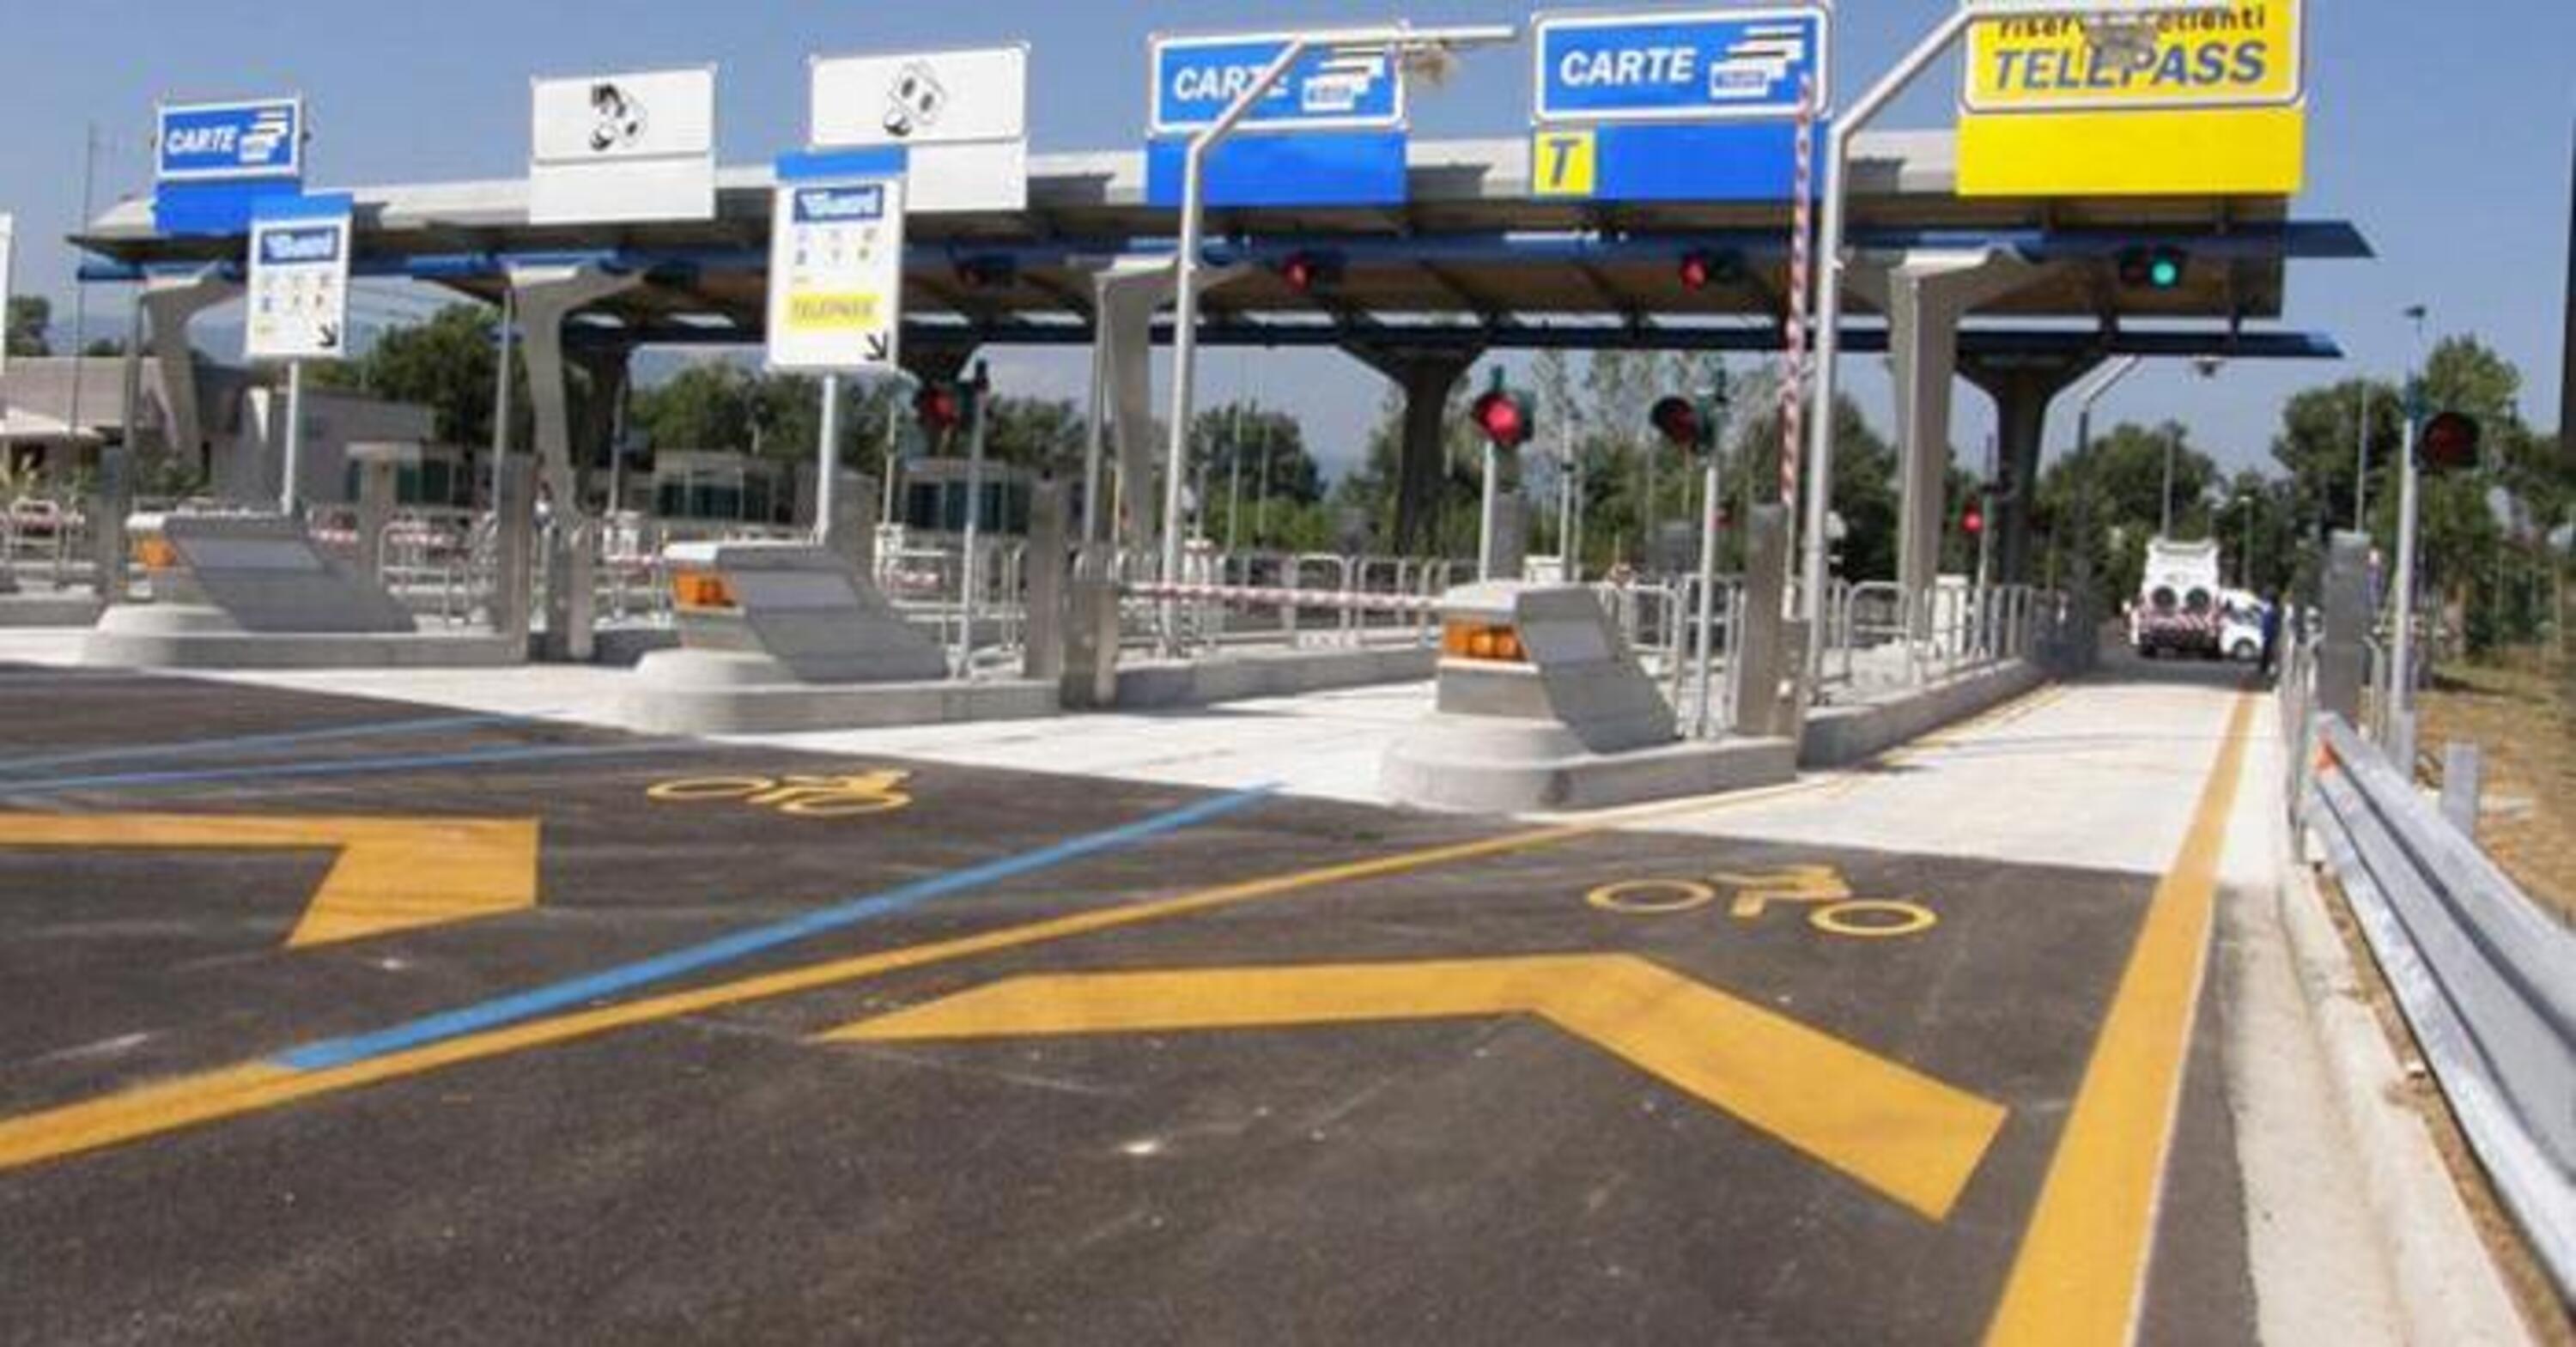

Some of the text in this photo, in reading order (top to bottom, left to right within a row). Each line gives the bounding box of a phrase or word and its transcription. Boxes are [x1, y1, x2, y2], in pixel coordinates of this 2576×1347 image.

[1560, 46, 1697, 86] CARTE
[1995, 39, 2267, 89] TELEPASS
[166, 125, 239, 155] CARTE
[1547, 138, 1581, 187] T
